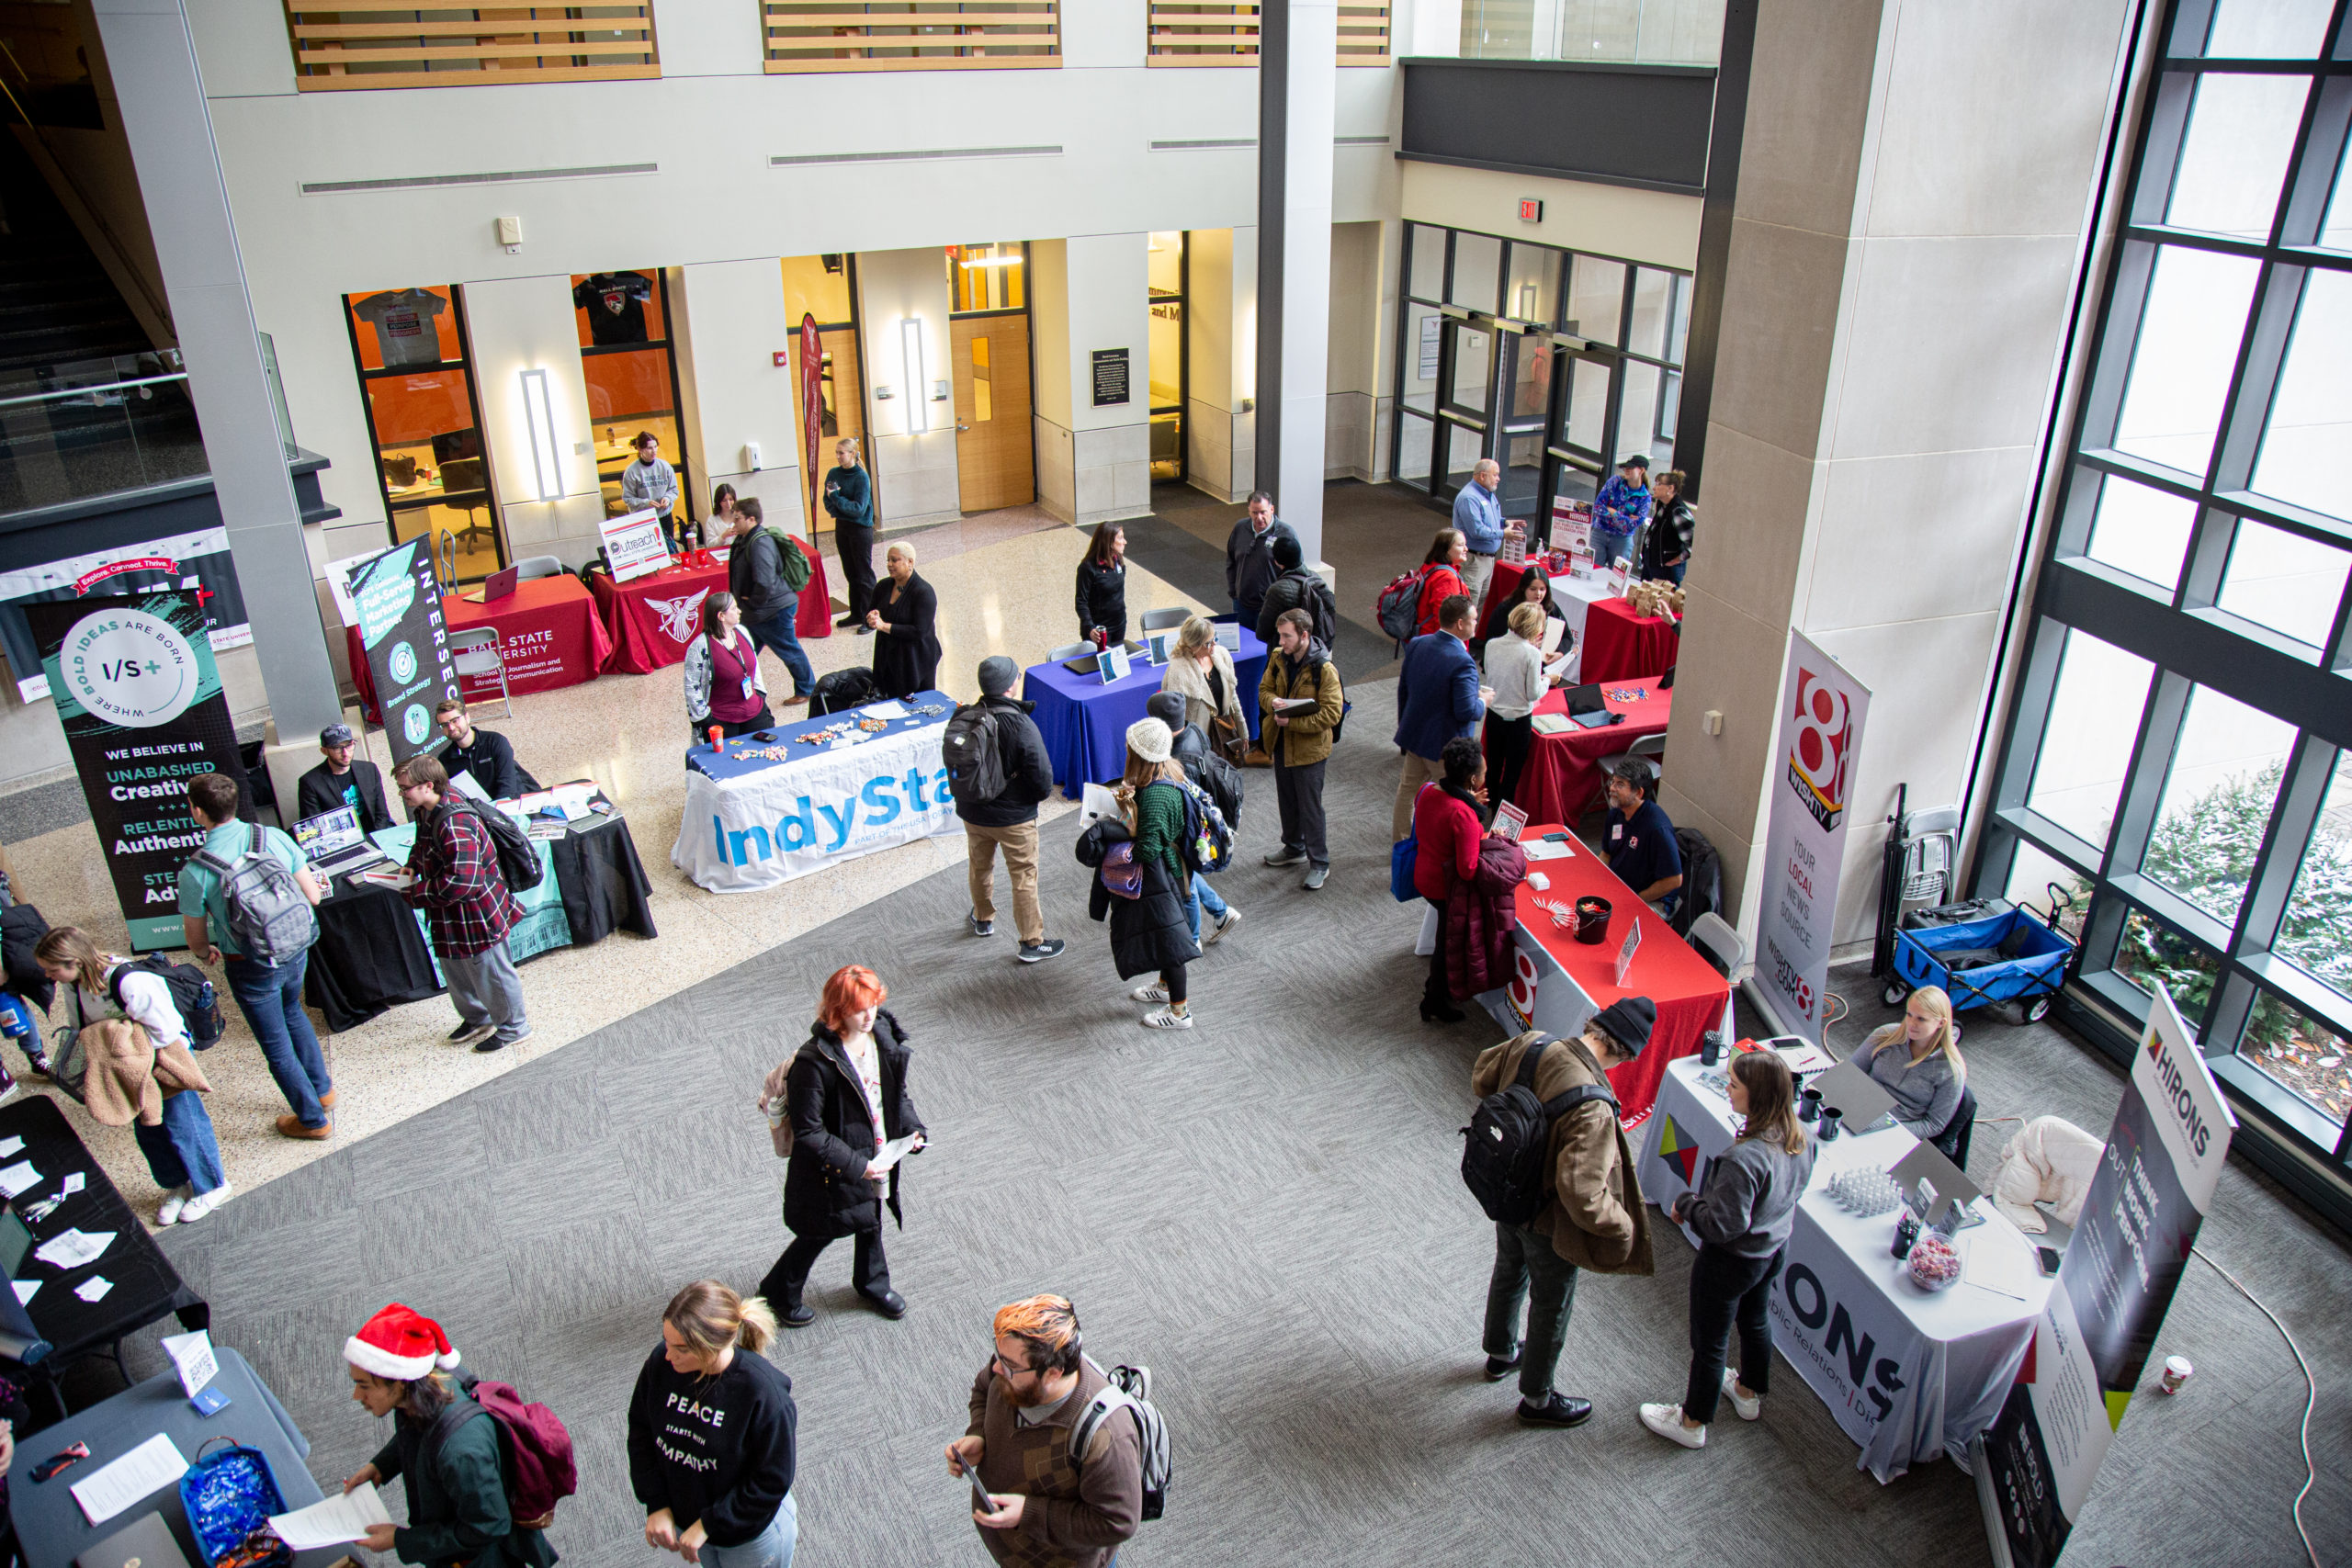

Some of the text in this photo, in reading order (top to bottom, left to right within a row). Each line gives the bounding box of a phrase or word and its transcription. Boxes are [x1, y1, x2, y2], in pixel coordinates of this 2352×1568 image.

[1521, 200, 1536, 220] EXIT
[1152, 305, 1180, 321] and M
[1569, 512, 1589, 523] HIRING
[81, 559, 168, 585] Explore. Connect. Thrive.
[362, 576, 416, 612] Full-Service
[366, 594, 412, 625] Marketing
[206, 618, 217, 626] IR
[368, 614, 402, 637] Partner
[416, 558, 458, 700] INTERSEC
[503, 644, 548, 660] ERSITY
[509, 630, 553, 647] STATE
[74, 620, 184, 717] WHERE BOLD IDEAS ARE BORN
[473, 669, 498, 679] School
[507, 660, 547, 673] Journalism
[508, 667, 563, 681] Communication
[387, 677, 432, 709] Brand Strategy
[424, 735, 448, 754] Services
[1792, 675, 1846, 788] 8
[106, 741, 205, 761] WE BELIEVE IN
[107, 761, 216, 783] UNABASHED
[110, 779, 190, 802] Creativ
[1790, 766, 1828, 824] WISHTV
[123, 817, 205, 836] RELENTL
[713, 767, 956, 868] IndySta
[1500, 805, 1524, 822] INTERNSHIPS
[115, 829, 207, 855] Authenti
[854, 833, 878, 846] PART
[879, 829, 890, 839] OF
[910, 817, 927, 828] USA
[1793, 836, 1815, 873] YOUR
[143, 871, 179, 886] STE
[1788, 857, 1814, 899] LOCAL
[1787, 882, 1810, 920] NEWS
[1781, 901, 1813, 949] SOURCE
[1768, 935, 1798, 985] WISHTV
[2156, 1046, 2211, 1157] HIRONS
[2108, 1143, 2160, 1218] OUT THINK.
[2124, 1178, 2150, 1241] WORK.
[2115, 1201, 2150, 1293] PERFORM.
[1768, 1299, 1792, 1330] blic
[1792, 1326, 1848, 1397] Relations
[1773, 1262, 1906, 1423] ONS
[666, 1392, 725, 1427] PEACE
[665, 1424, 706, 1446] STARTS WITH
[656, 1436, 718, 1472] EMPATHY
